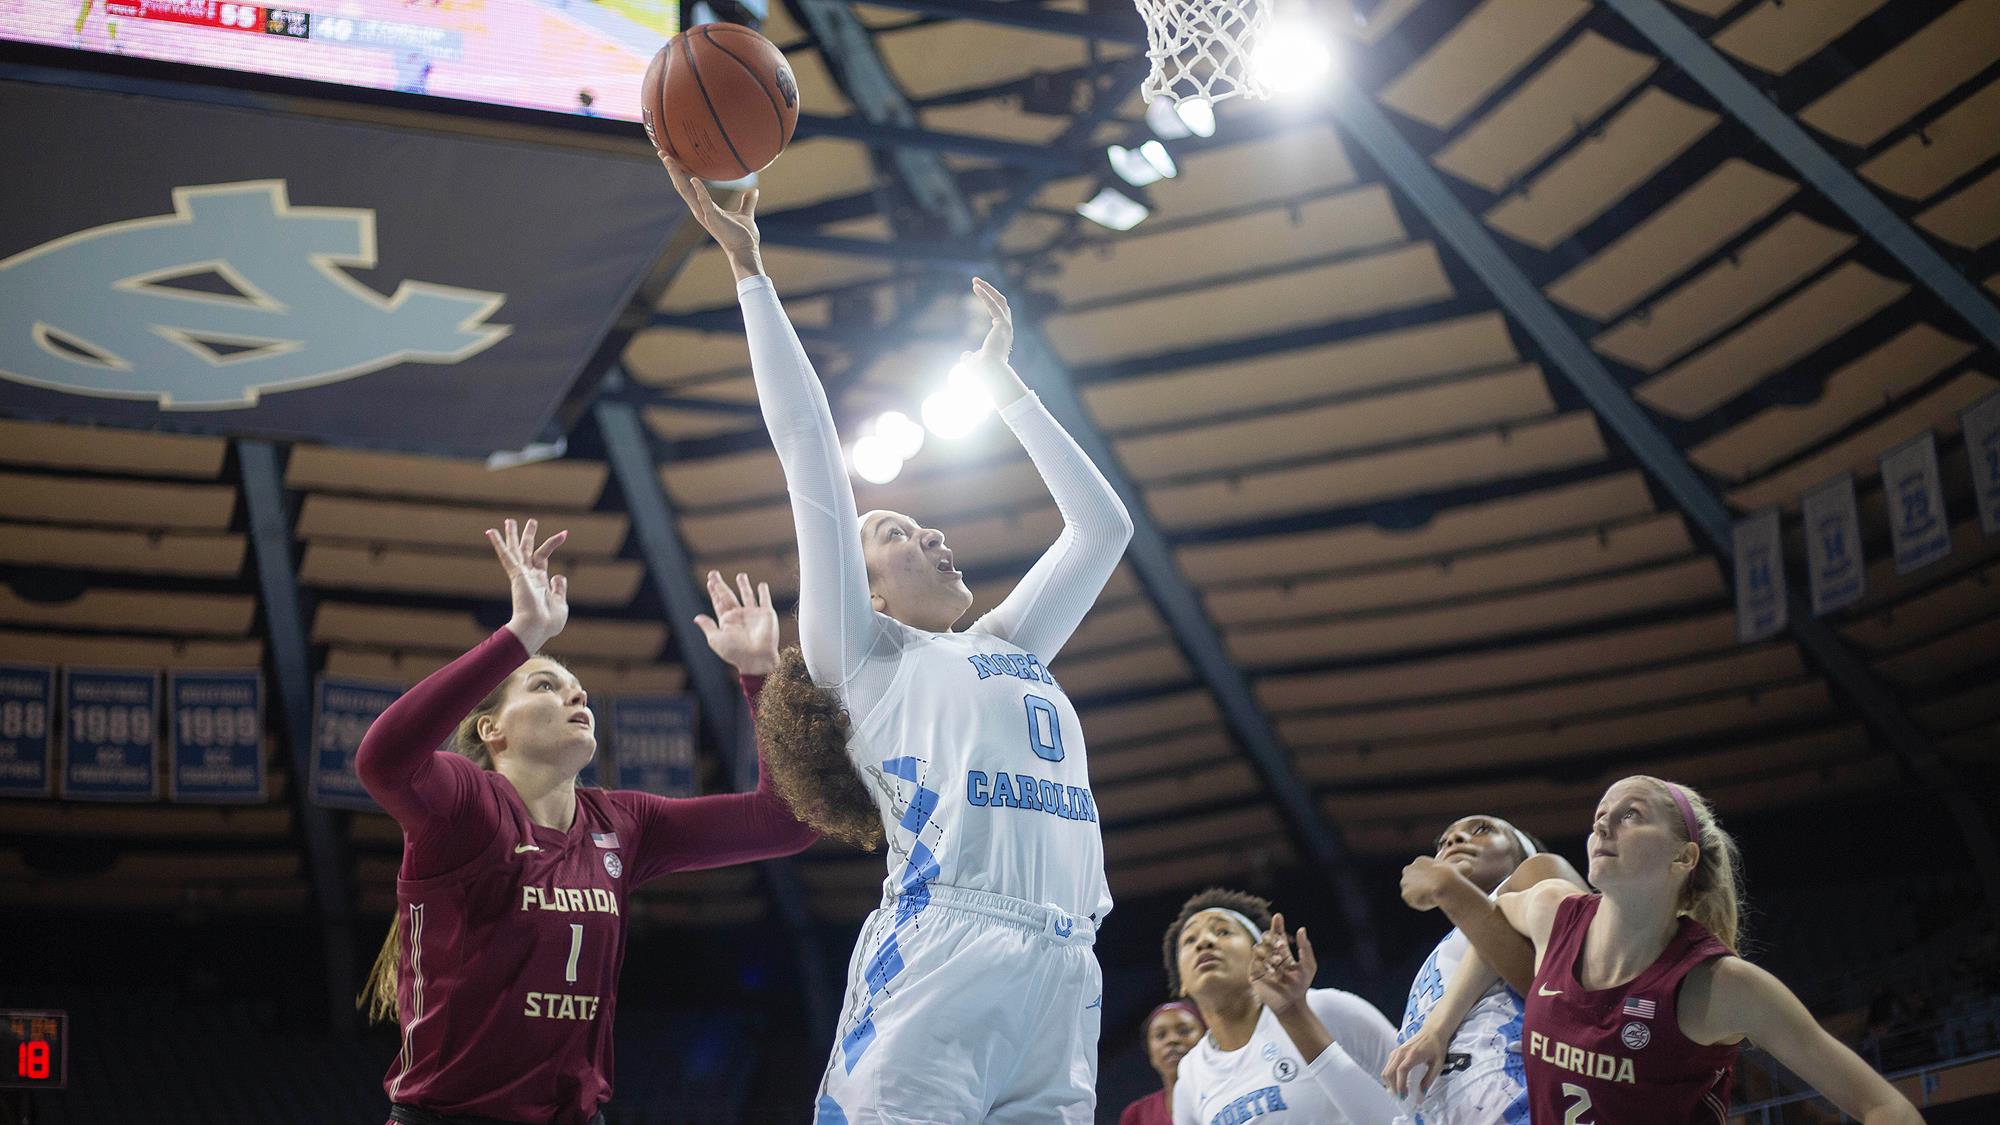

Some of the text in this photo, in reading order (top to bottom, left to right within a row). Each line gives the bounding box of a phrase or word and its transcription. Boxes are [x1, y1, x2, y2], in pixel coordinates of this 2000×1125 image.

[220, 4, 257, 28] 55
[968, 653, 1064, 692] NORT
[72, 705, 151, 745] 1989
[178, 706, 257, 746] 1999
[1023, 693, 1065, 763] 0
[521, 886, 620, 917] FLORIDA
[565, 923, 584, 982] 1
[18, 1040, 50, 1080] 18
[1530, 1030, 1636, 1085] FLORIDA
[1562, 1082, 1595, 1125] 2
